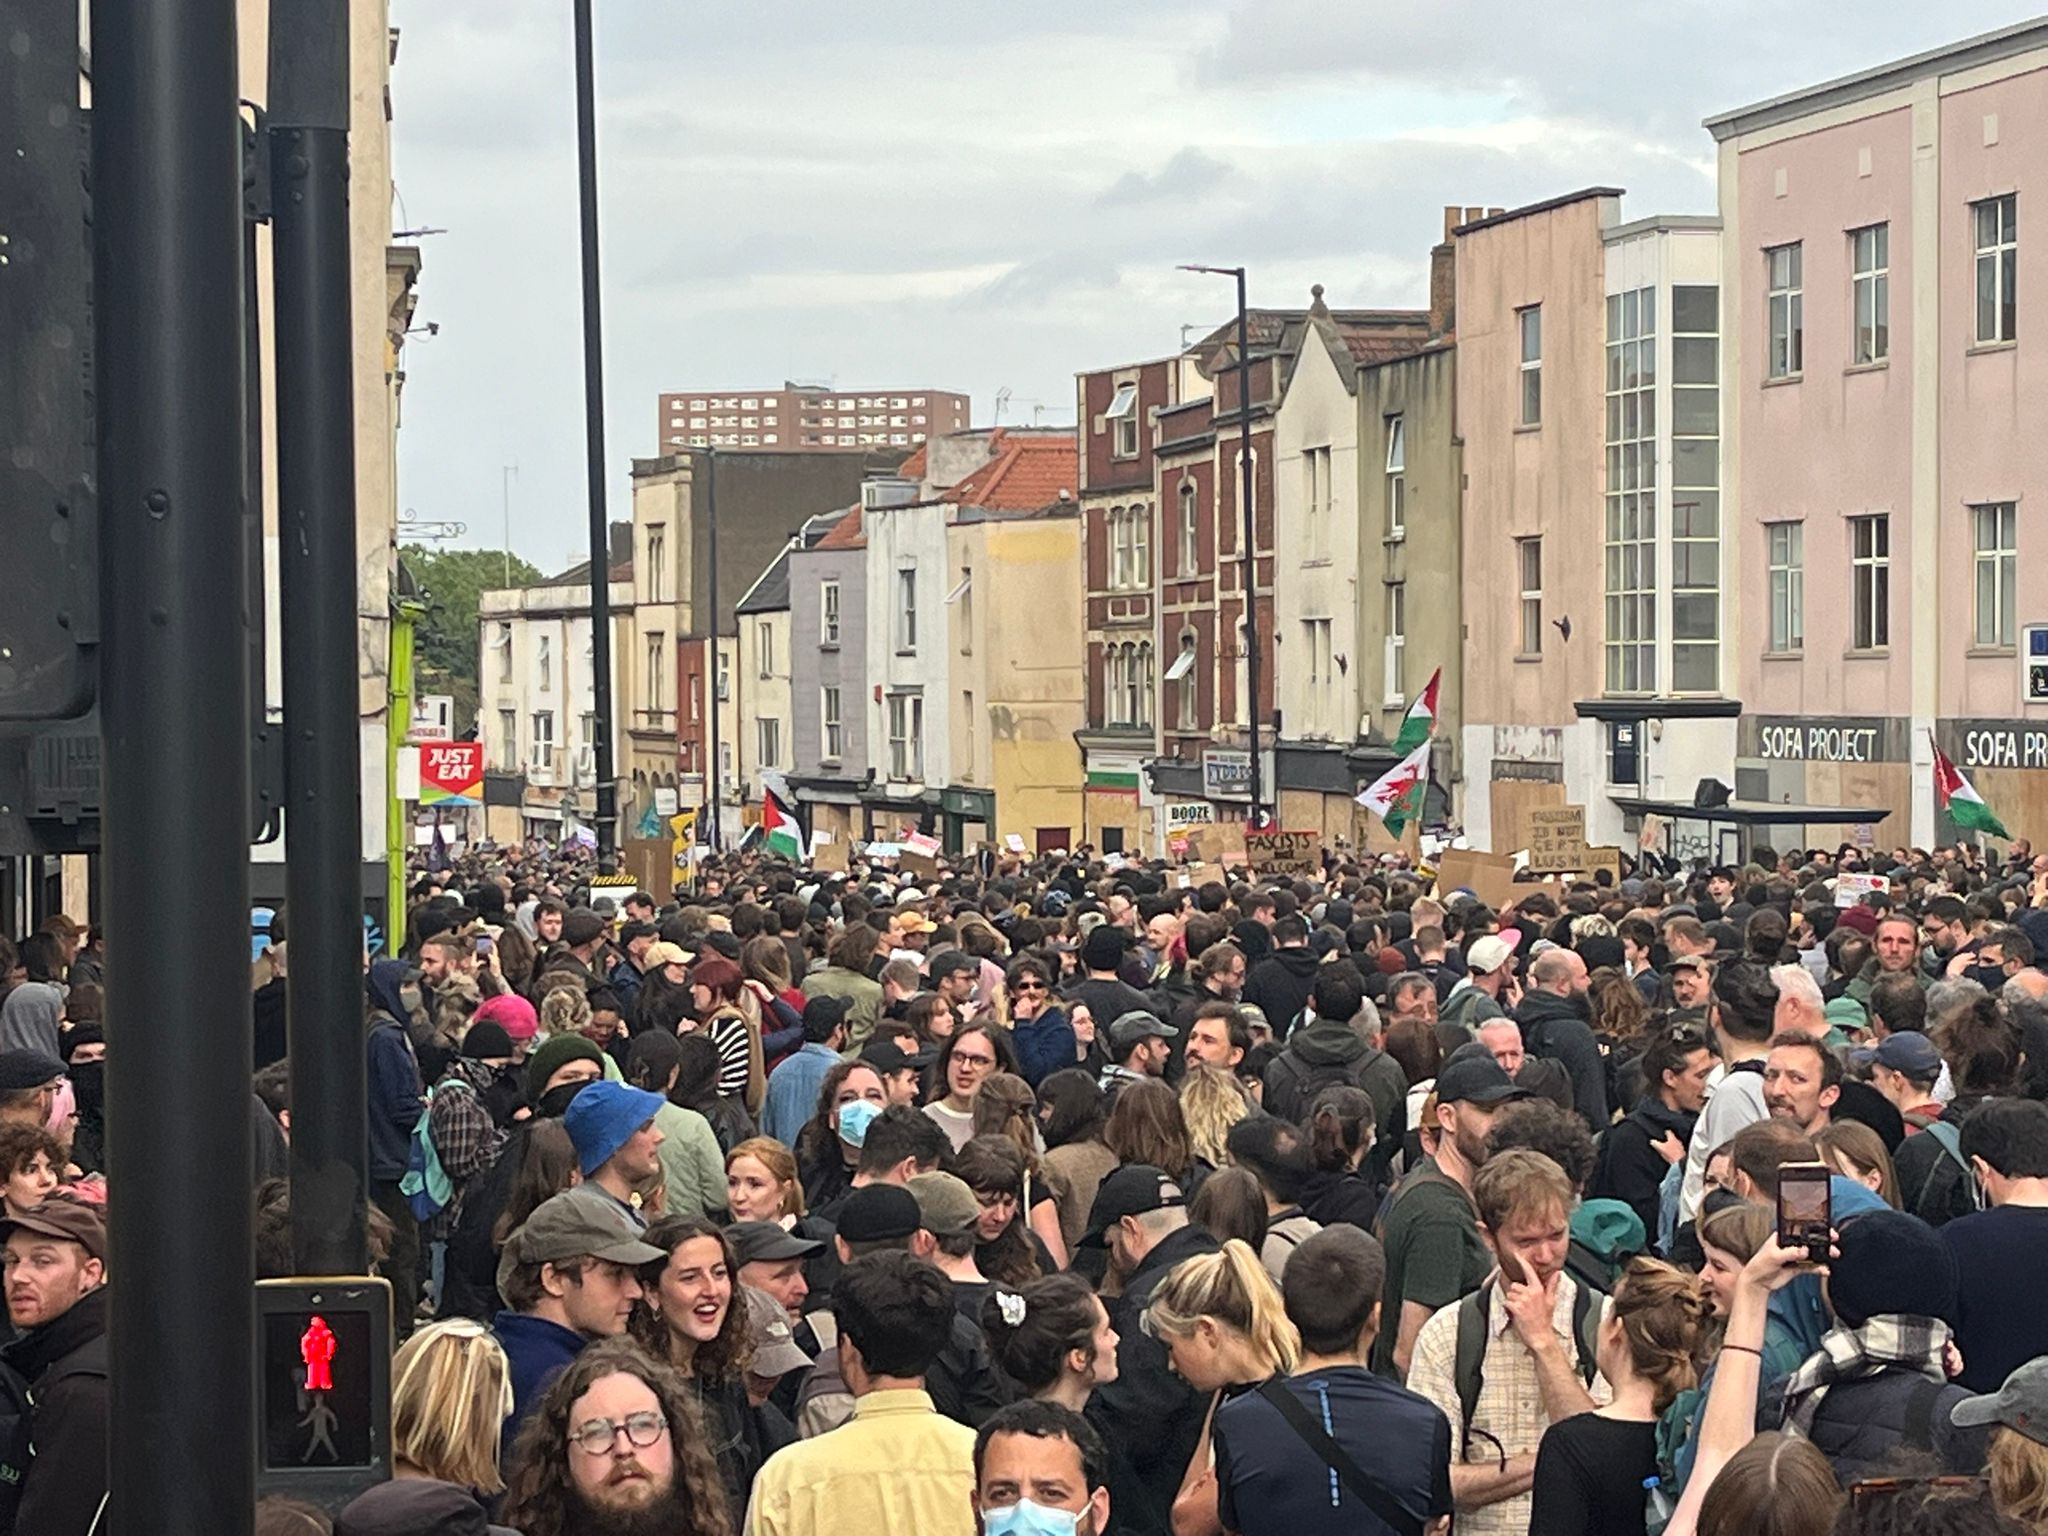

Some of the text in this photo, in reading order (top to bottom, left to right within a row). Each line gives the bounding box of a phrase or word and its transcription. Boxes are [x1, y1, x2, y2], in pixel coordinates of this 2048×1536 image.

[1761, 726, 1877, 761] SOFA PROJECT
[1966, 730, 2047, 768] SOFA PR
[428, 748, 474, 767] JUST
[437, 764, 474, 780] EAT
[1171, 805, 1210, 820] BOOZE
[1246, 833, 1310, 853] FASCISTS
[1253, 860, 1315, 875] WELCOME
[1534, 855, 1580, 869] LUSH
